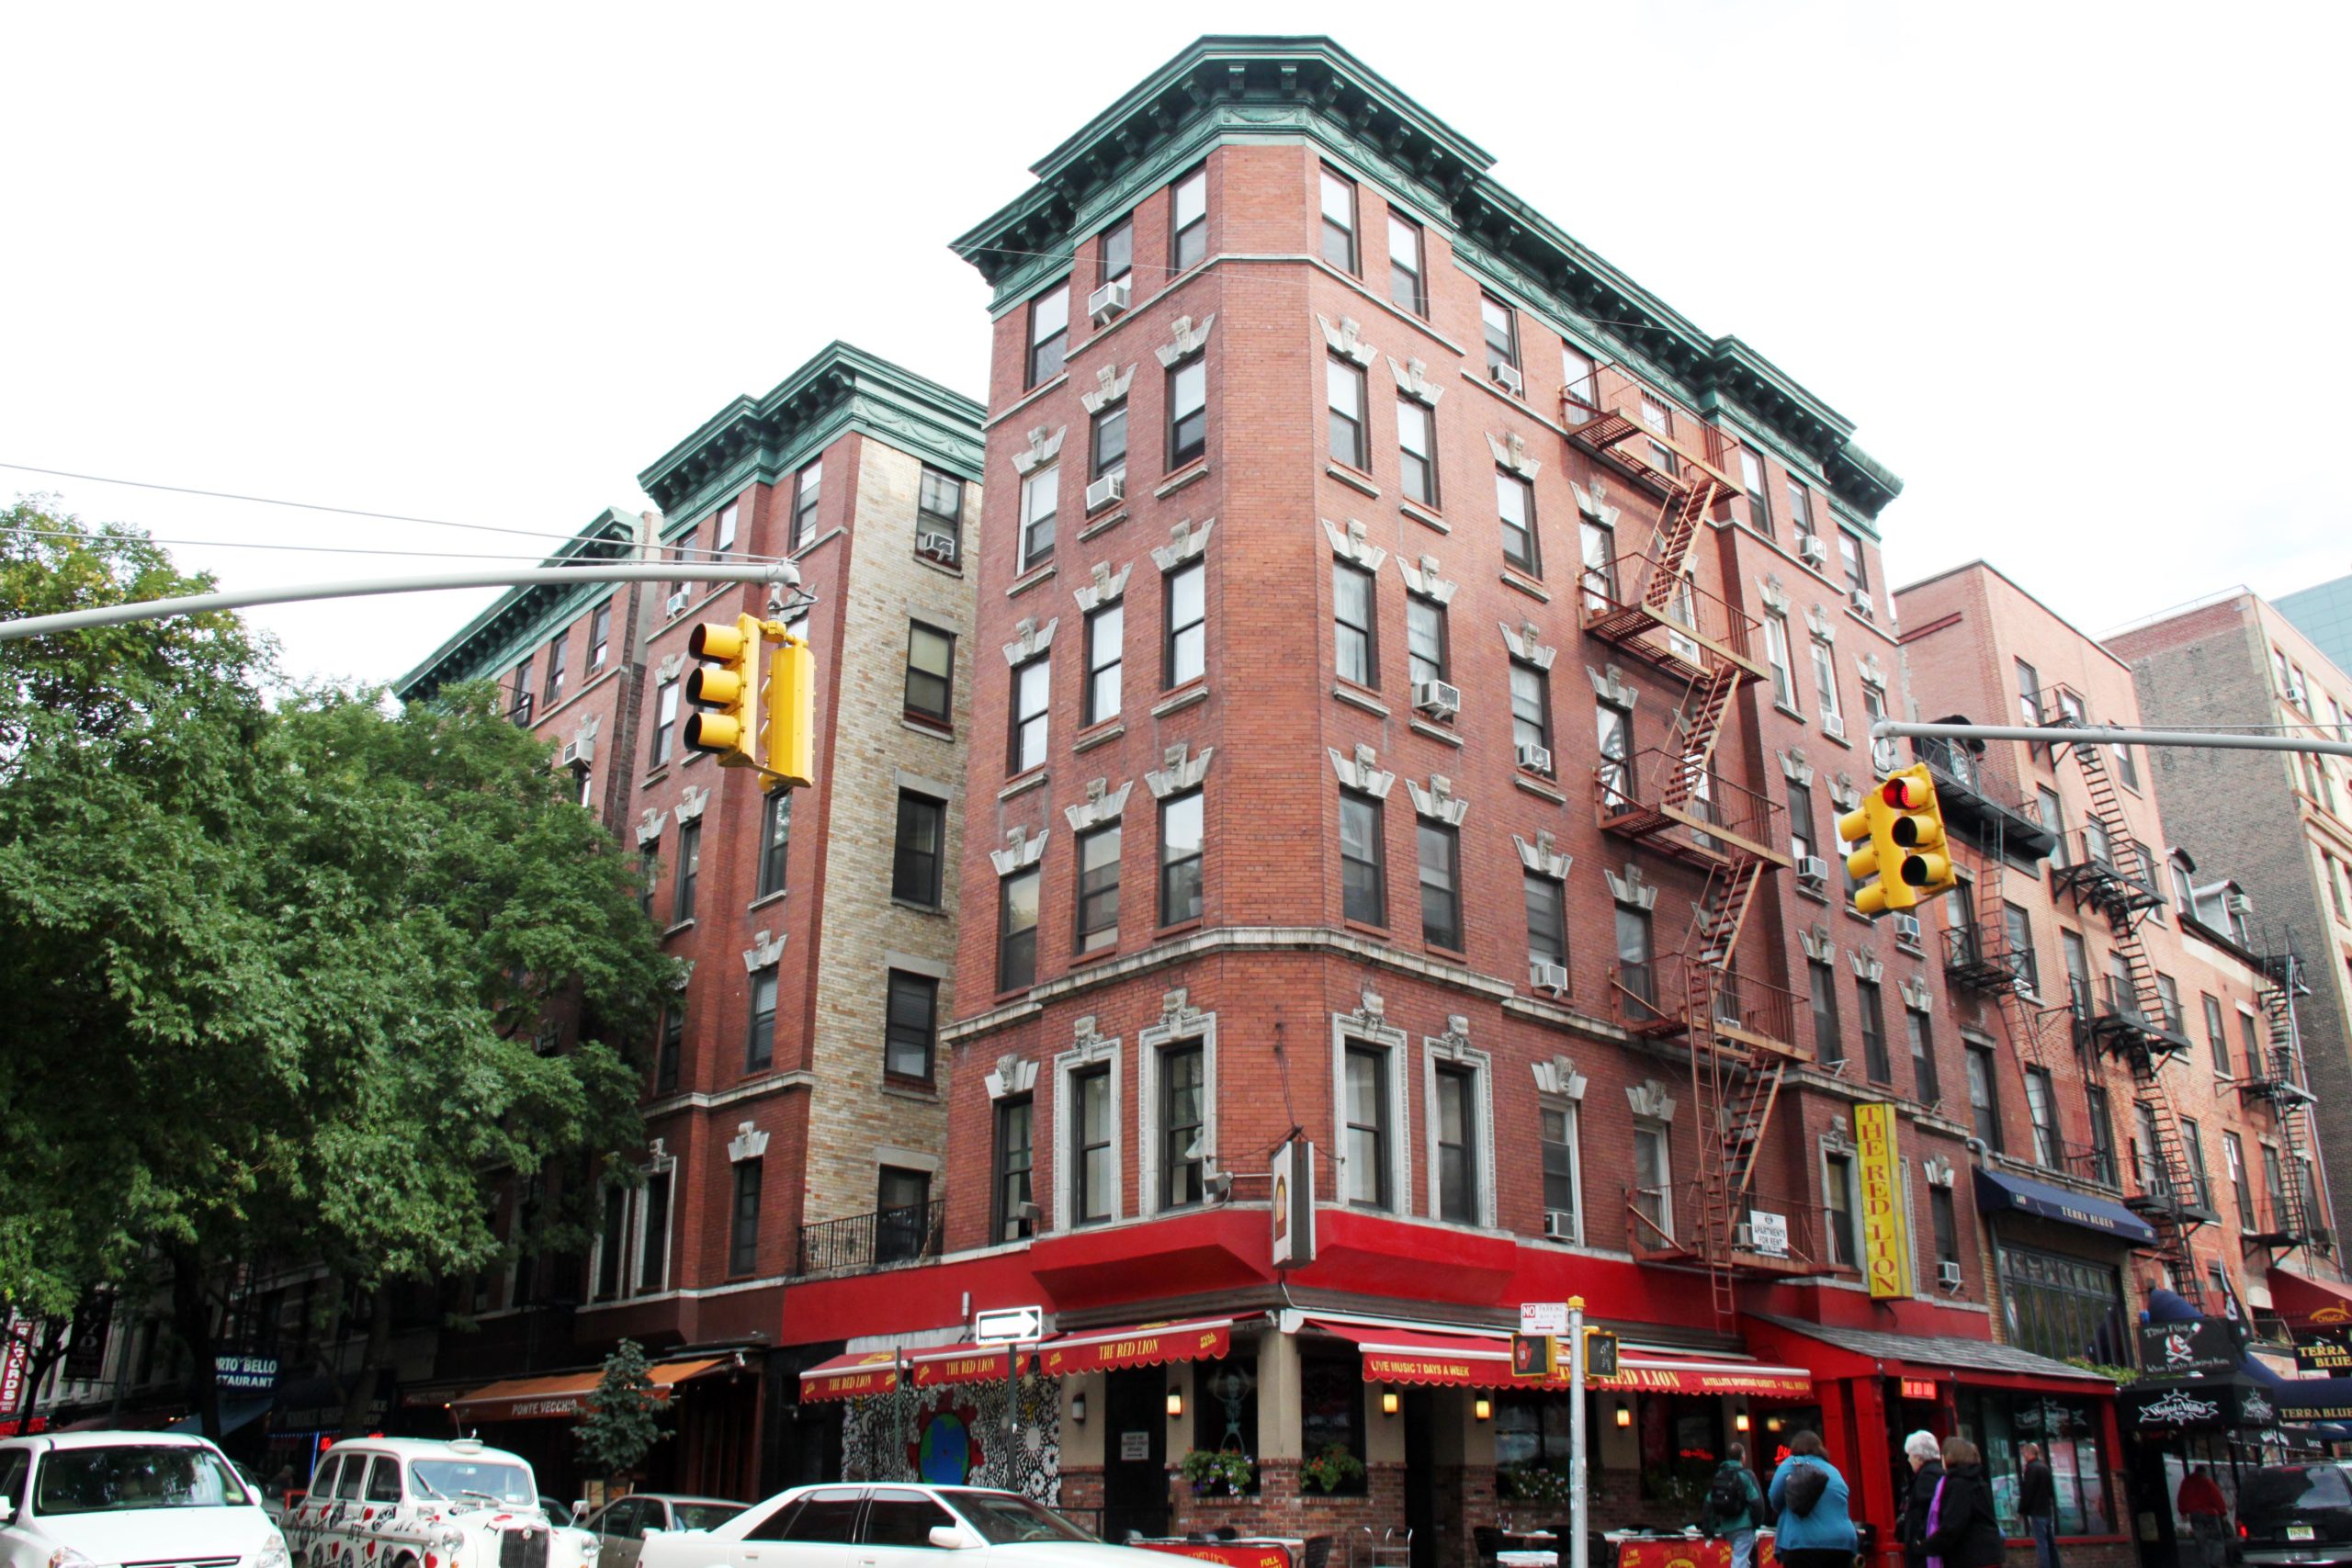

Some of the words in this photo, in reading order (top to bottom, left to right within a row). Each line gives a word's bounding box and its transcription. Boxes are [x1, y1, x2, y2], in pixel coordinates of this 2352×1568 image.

[1860, 1106, 1883, 1157] THE
[1867, 1165, 1890, 1216] RED
[2061, 1206, 2088, 1223] TERRA
[2089, 1214, 2114, 1228] BLUES
[1754, 1225, 1785, 1238] APARTMENTS
[1758, 1235, 1769, 1243] FOR
[1770, 1237, 1782, 1246] RENT
[1873, 1224, 1896, 1294] LION
[1522, 1306, 1535, 1316] NO
[1099, 1345, 1114, 1360] THE
[1117, 1342, 1135, 1359] RED
[1137, 1338, 1159, 1356] LION
[2298, 1345, 2347, 1358] TERRA
[243, 1359, 277, 1374] BELLO
[946, 1361, 959, 1375] THE
[962, 1359, 976, 1374] RED
[978, 1358, 995, 1372] LION
[1371, 1360, 1390, 1371] LIVE
[1390, 1362, 1416, 1373] MUSIC
[1416, 1364, 1421, 1373] 7
[1423, 1364, 1442, 1375] DAYS
[1442, 1365, 1449, 1375] A
[1450, 1366, 1470, 1376] WEEK
[829, 1378, 841, 1391] THE
[842, 1376, 855, 1390] RED
[855, 1374, 872, 1388] LION
[1641, 1370, 1680, 1388] LION
[512, 1401, 538, 1416] PONTE
[2279, 1407, 2321, 1418] TERRA
[1260, 1555, 1280, 1567] FULL
